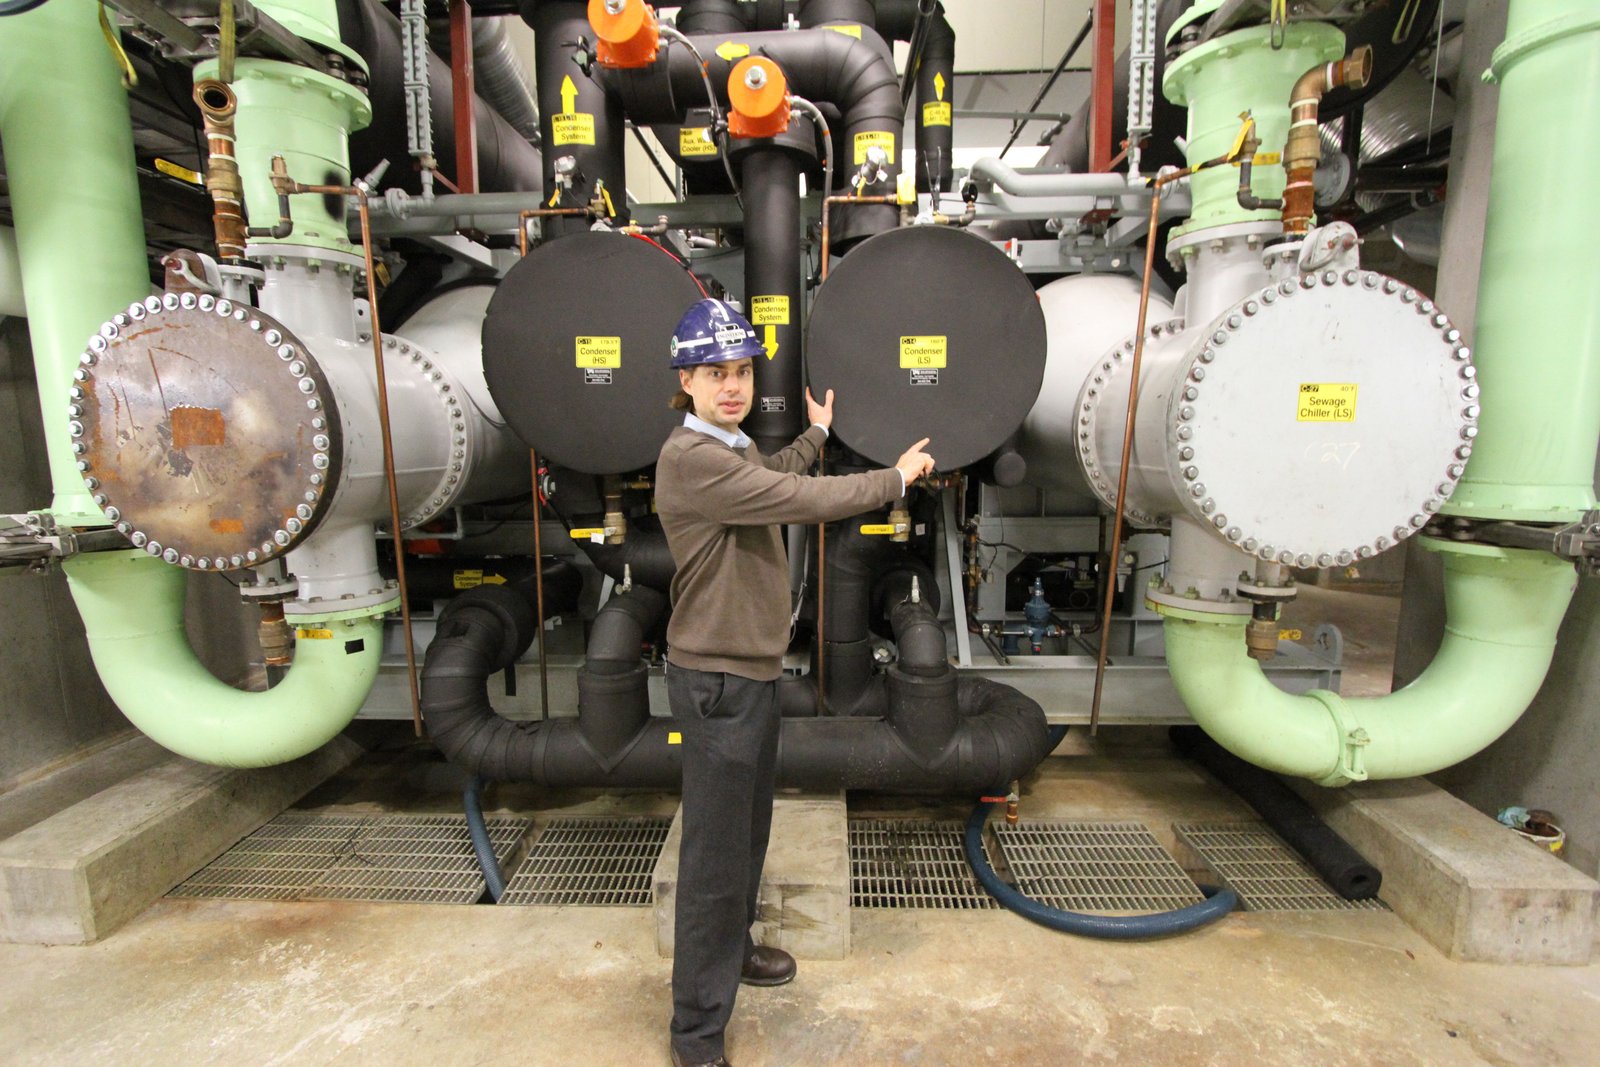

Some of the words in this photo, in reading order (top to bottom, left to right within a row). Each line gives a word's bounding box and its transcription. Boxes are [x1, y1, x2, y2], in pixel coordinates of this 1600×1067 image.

[561, 133, 586, 141] System
[759, 314, 782, 322] System
[580, 347, 617, 355] Condenser
[904, 347, 943, 355] Condenser
[1309, 396, 1346, 408] Sewage
[1300, 408, 1330, 417] Chiller
[1333, 408, 1353, 419] (LS)
